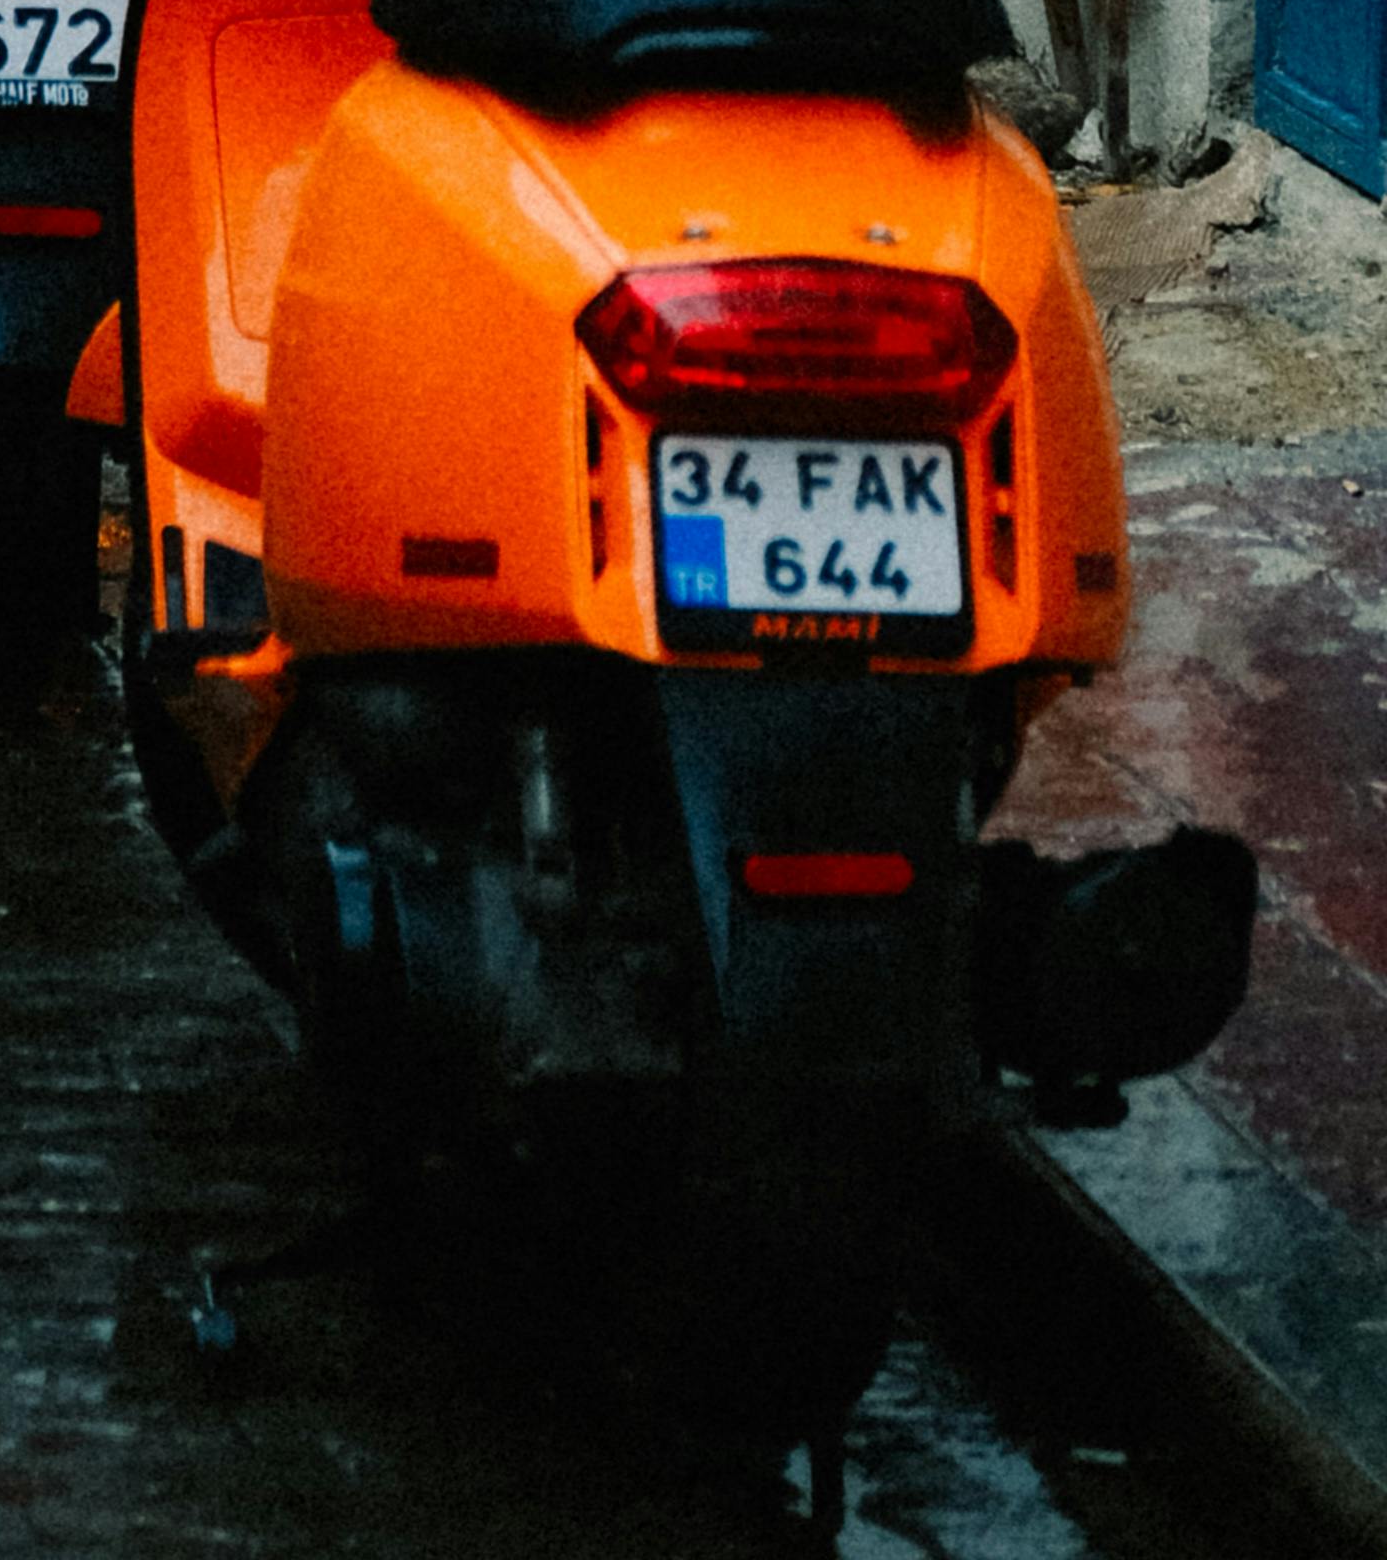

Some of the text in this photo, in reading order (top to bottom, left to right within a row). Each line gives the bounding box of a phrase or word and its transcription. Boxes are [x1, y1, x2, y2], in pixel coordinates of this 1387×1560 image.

[669, 450, 944, 516] 34 FAK
[676, 537, 910, 602] TR 644
